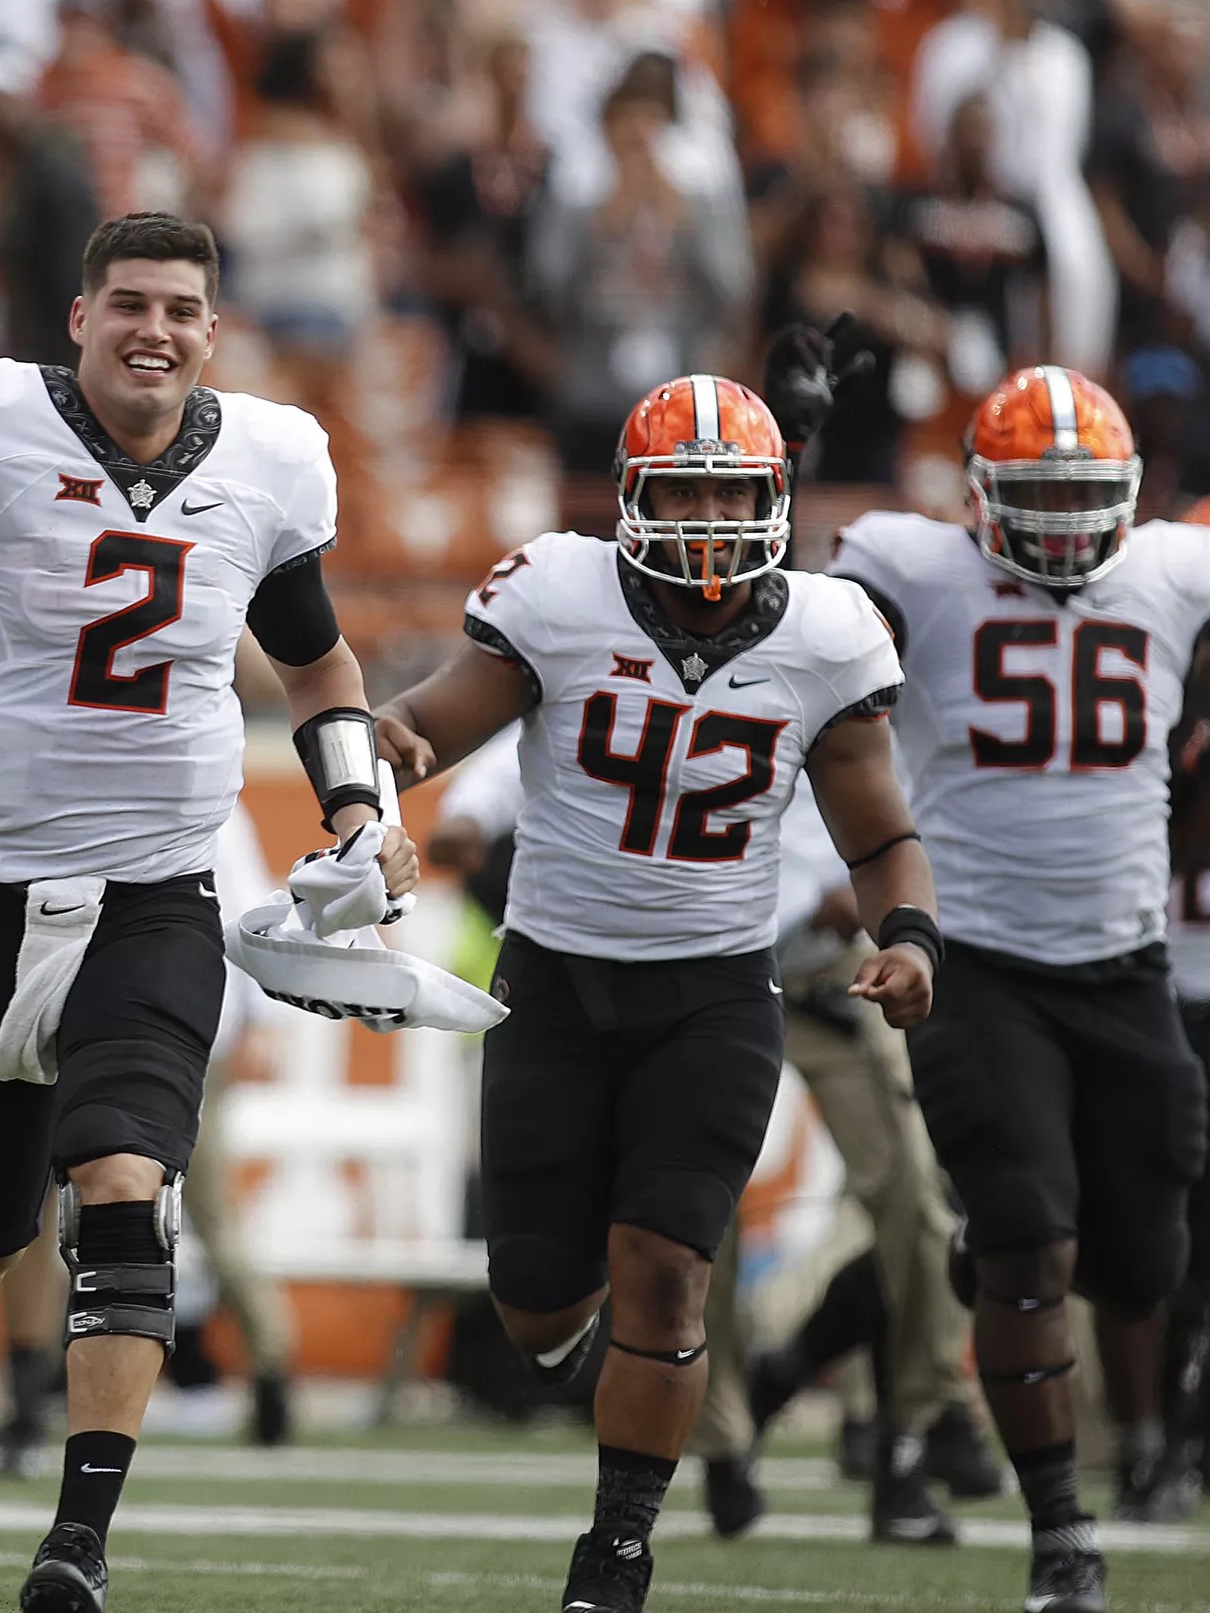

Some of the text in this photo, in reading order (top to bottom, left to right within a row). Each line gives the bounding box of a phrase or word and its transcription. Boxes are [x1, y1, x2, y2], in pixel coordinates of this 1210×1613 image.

[67, 529, 197, 715] 2
[968, 616, 1150, 773] 56
[577, 690, 790, 862] 42
